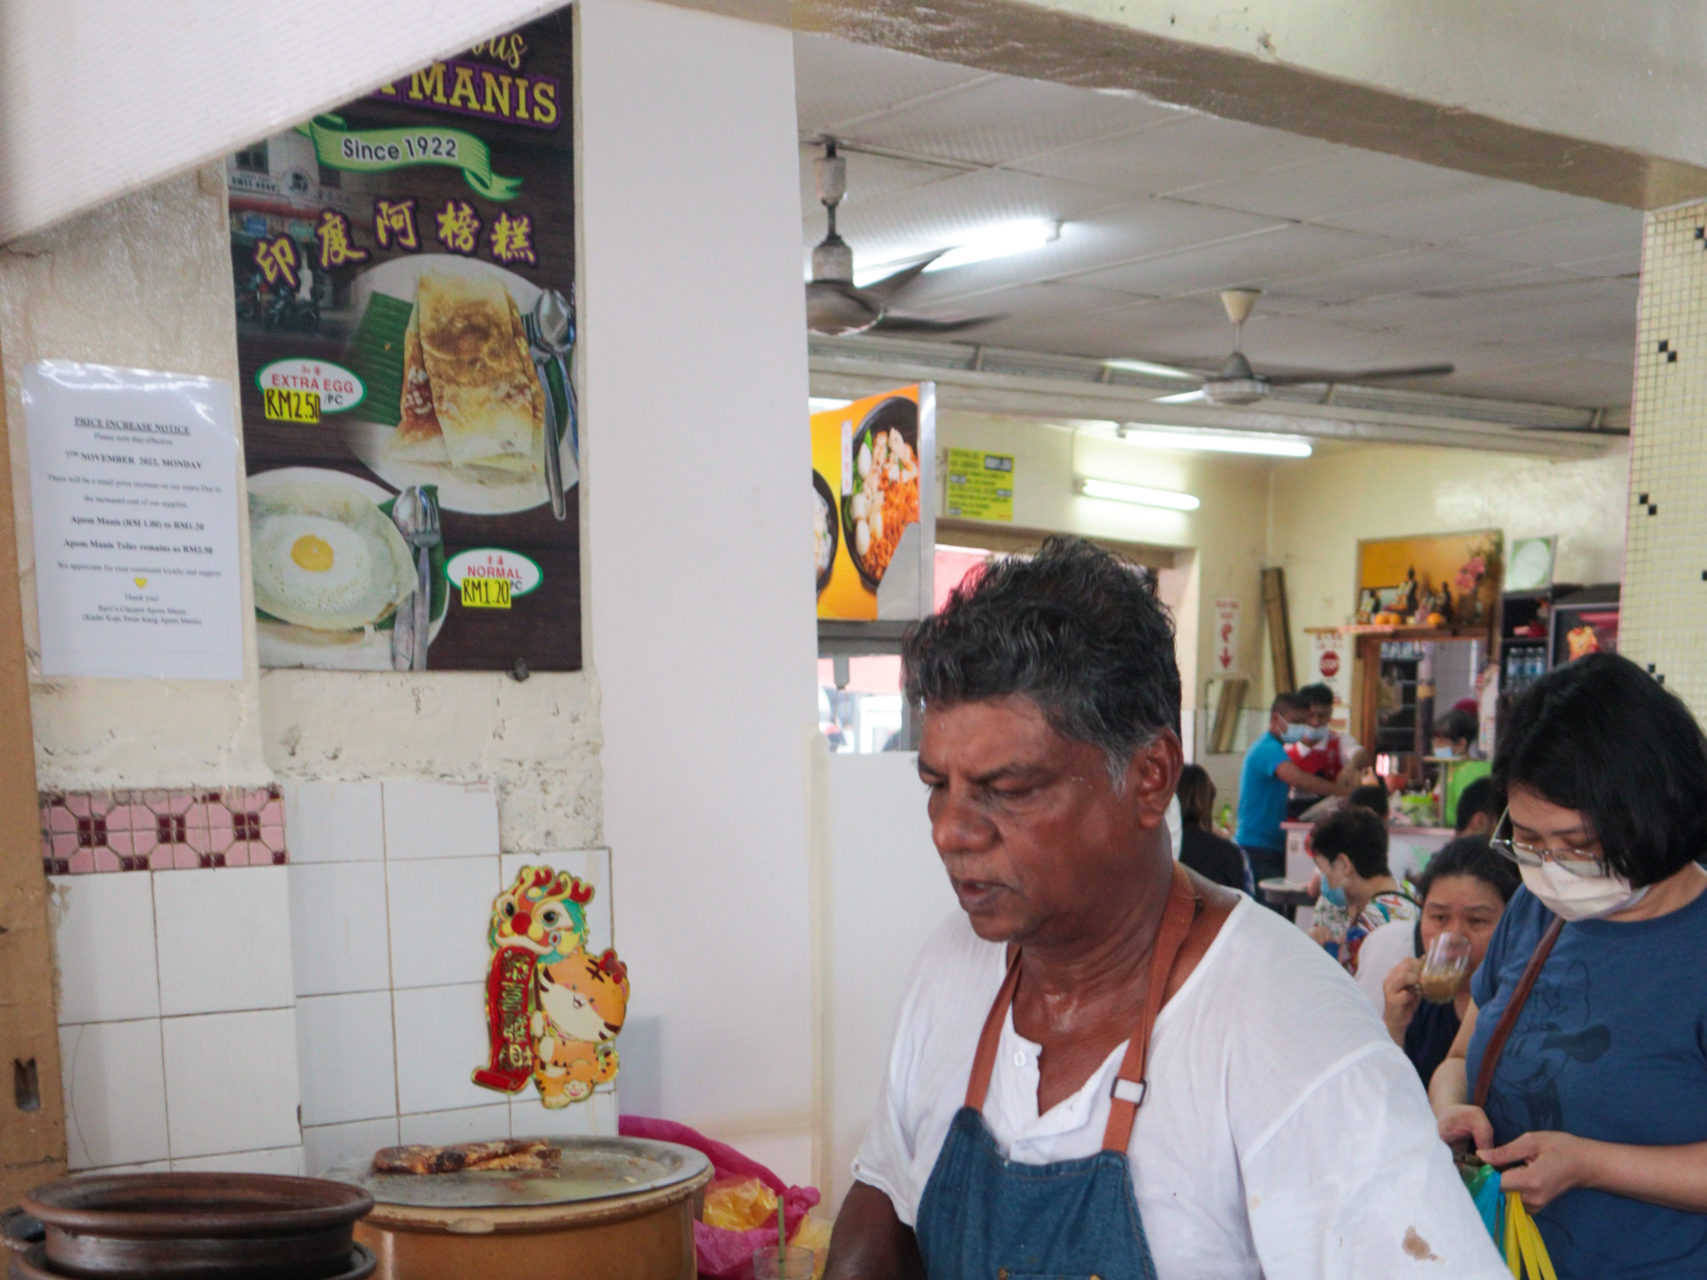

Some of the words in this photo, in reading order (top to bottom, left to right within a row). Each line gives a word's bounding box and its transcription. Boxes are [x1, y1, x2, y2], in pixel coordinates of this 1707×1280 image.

[471, 33, 528, 69] us
[408, 60, 557, 124] MANIS
[343, 138, 400, 160] Since
[404, 136, 456, 158] 1922
[254, 200, 535, 287] 印度阿榜糕
[271, 373, 320, 391] EXTRA
[323, 378, 354, 394] EGG
[265, 388, 321, 420] RM2.50
[74, 416, 105, 428] PRICE
[105, 420, 152, 432] INCREASE
[155, 424, 190, 436] NOTICE
[81, 452, 135, 465] NOVEMBER
[161, 459, 202, 470] MONDAY
[467, 565, 522, 580] NORMAL
